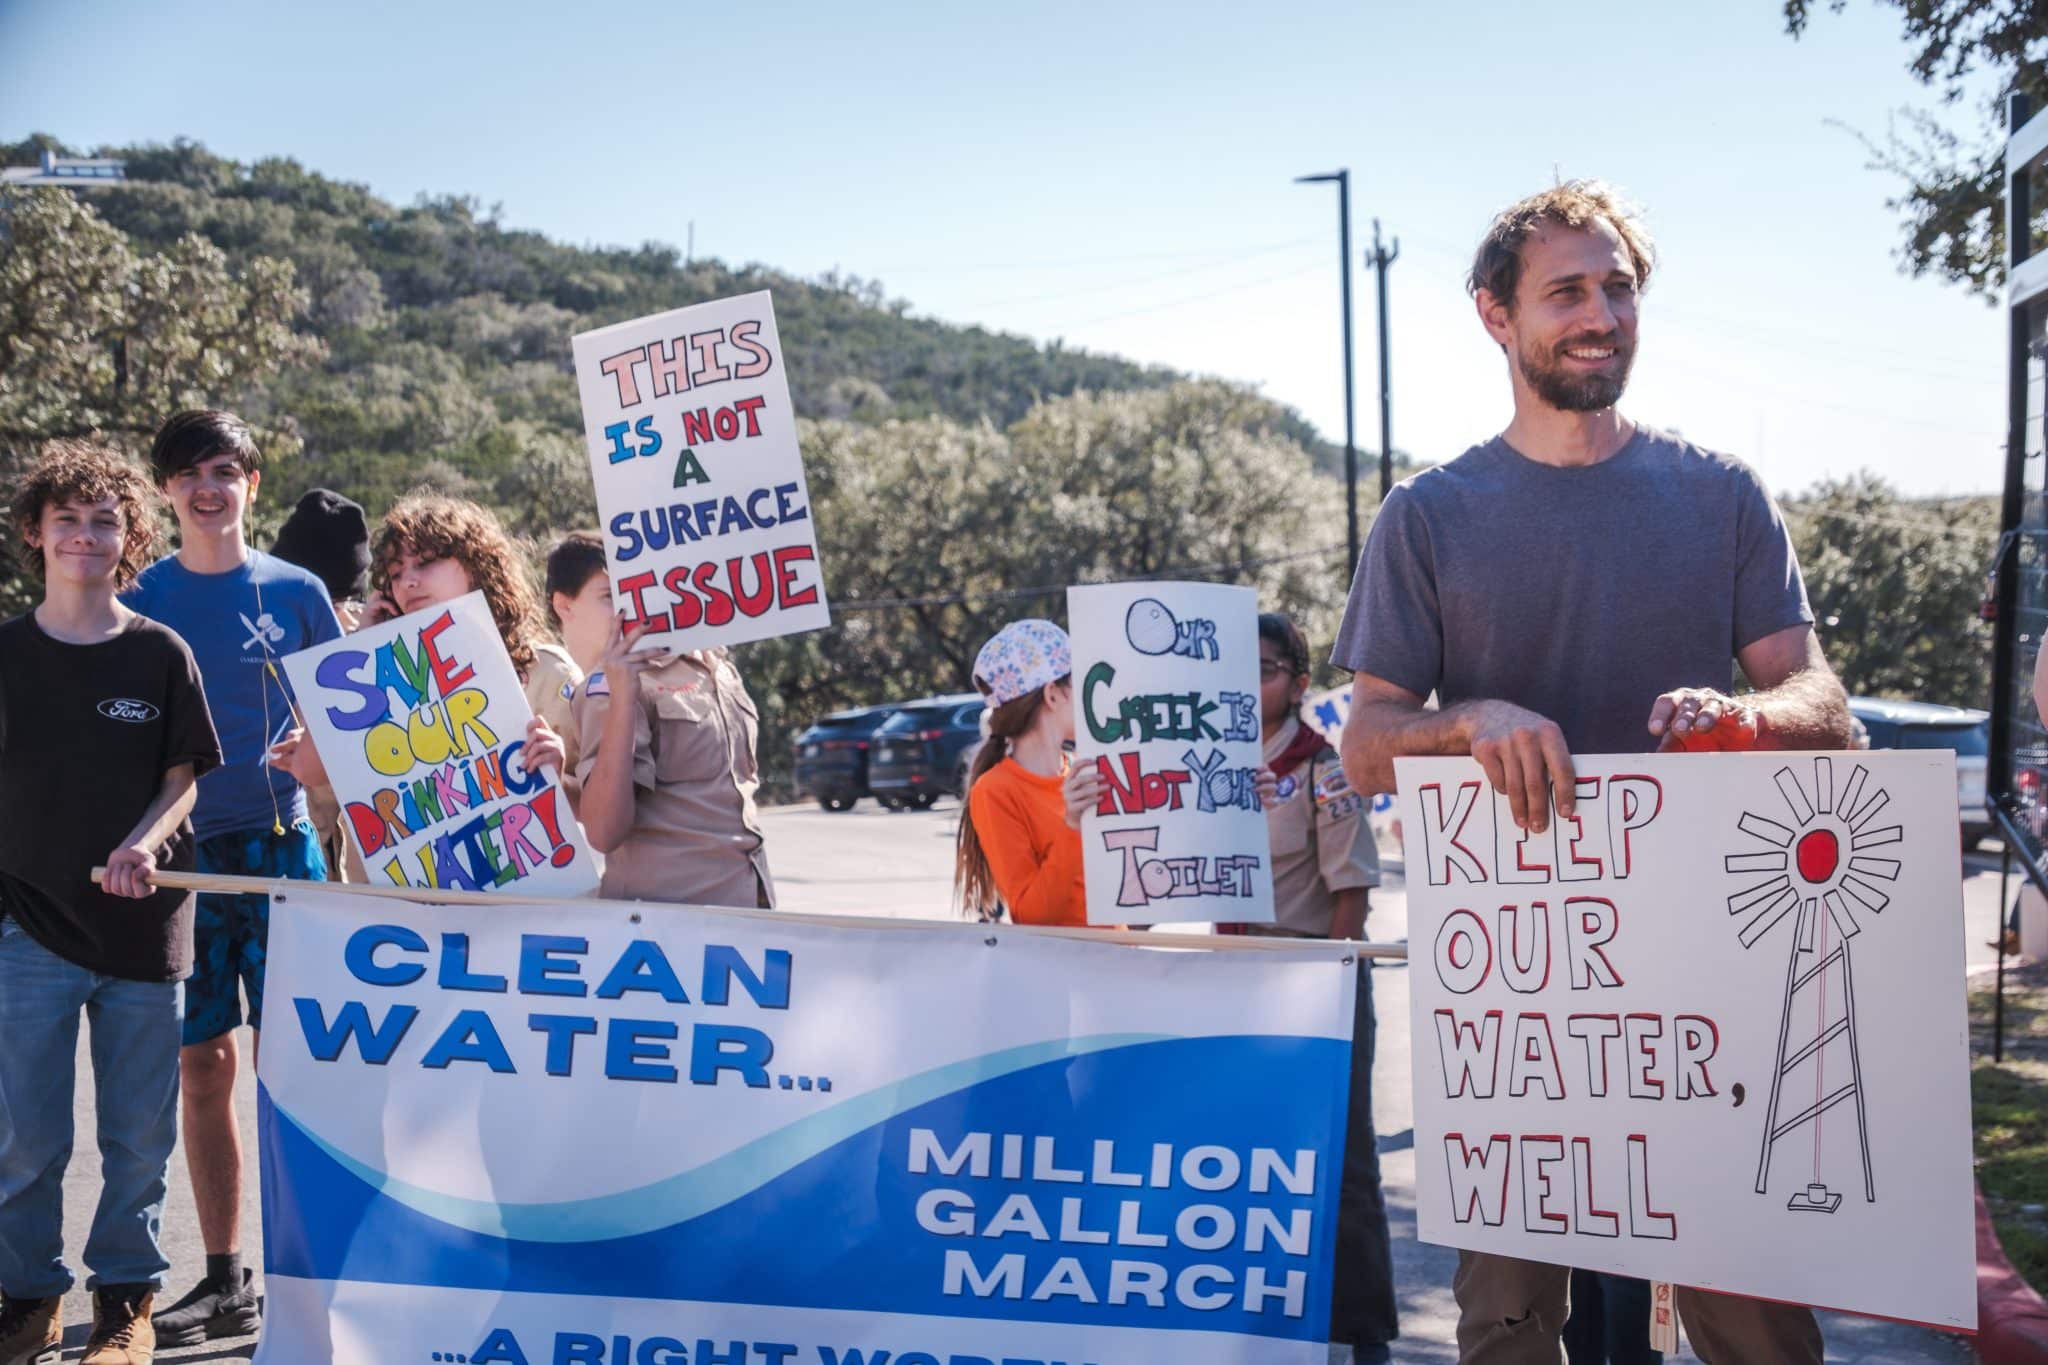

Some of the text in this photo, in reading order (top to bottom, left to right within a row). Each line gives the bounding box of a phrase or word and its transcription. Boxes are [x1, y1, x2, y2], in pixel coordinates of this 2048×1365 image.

[600, 320, 772, 408] THIS
[604, 395, 766, 464] IS NOT
[673, 449, 711, 488] A
[610, 482, 807, 561] SURFACE
[618, 545, 819, 637] ISSUE
[109, 701, 149, 719] Ford
[315, 610, 477, 731] SAVE
[1082, 661, 1223, 743] CREEK
[1219, 691, 1259, 742] IS
[364, 688, 500, 776] OUR
[1102, 826, 1260, 907] TOILET
[344, 923, 793, 1010] CLEAN
[1434, 897, 1625, 994] OUR
[293, 997, 832, 1092] WATER...
[1434, 1008, 1746, 1108] WATER,
[907, 1127, 1318, 1195] MILLION
[1444, 1133, 1677, 1240] WELL
[915, 1188, 1313, 1257] GALLON
[942, 1248, 1308, 1319] MARCH
